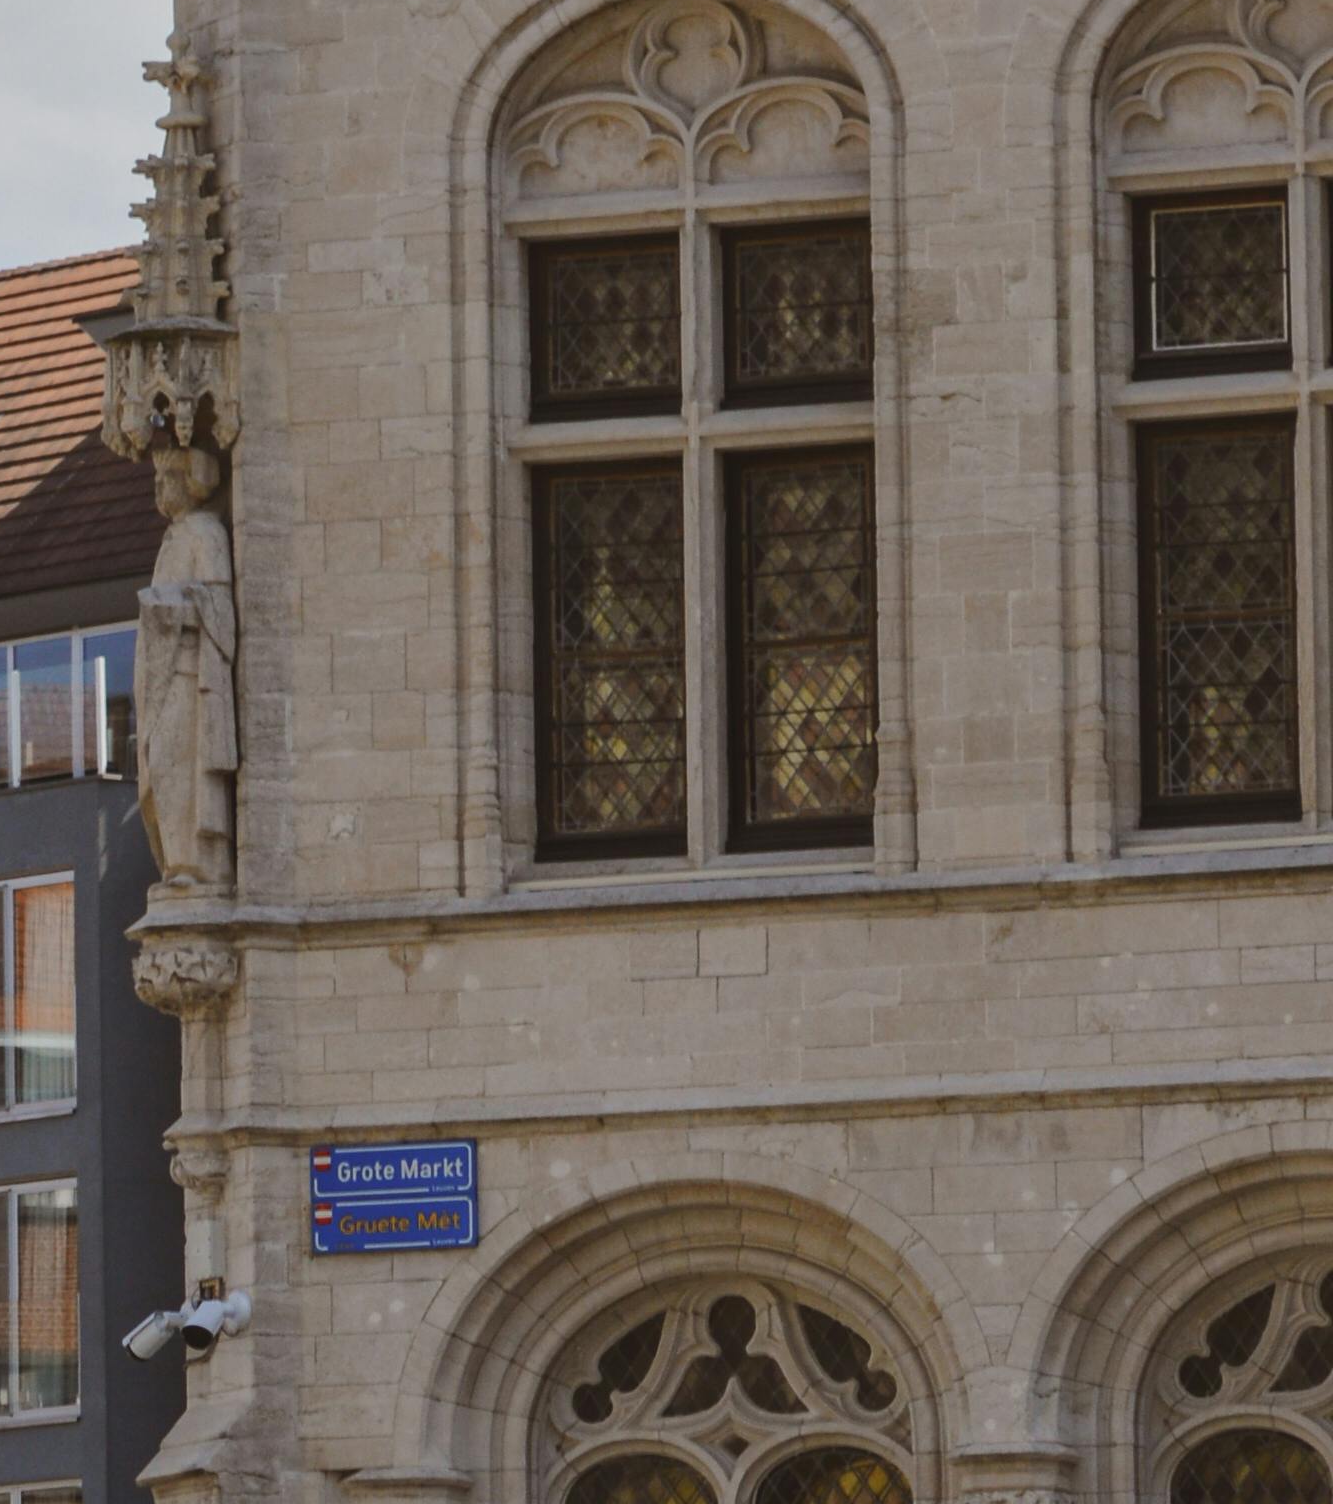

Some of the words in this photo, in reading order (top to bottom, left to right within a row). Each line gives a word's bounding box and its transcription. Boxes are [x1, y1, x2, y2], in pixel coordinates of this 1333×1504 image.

[337, 1161, 395, 1183] Grote
[400, 1157, 464, 1180] Markt
[339, 1214, 410, 1236] Gruete
